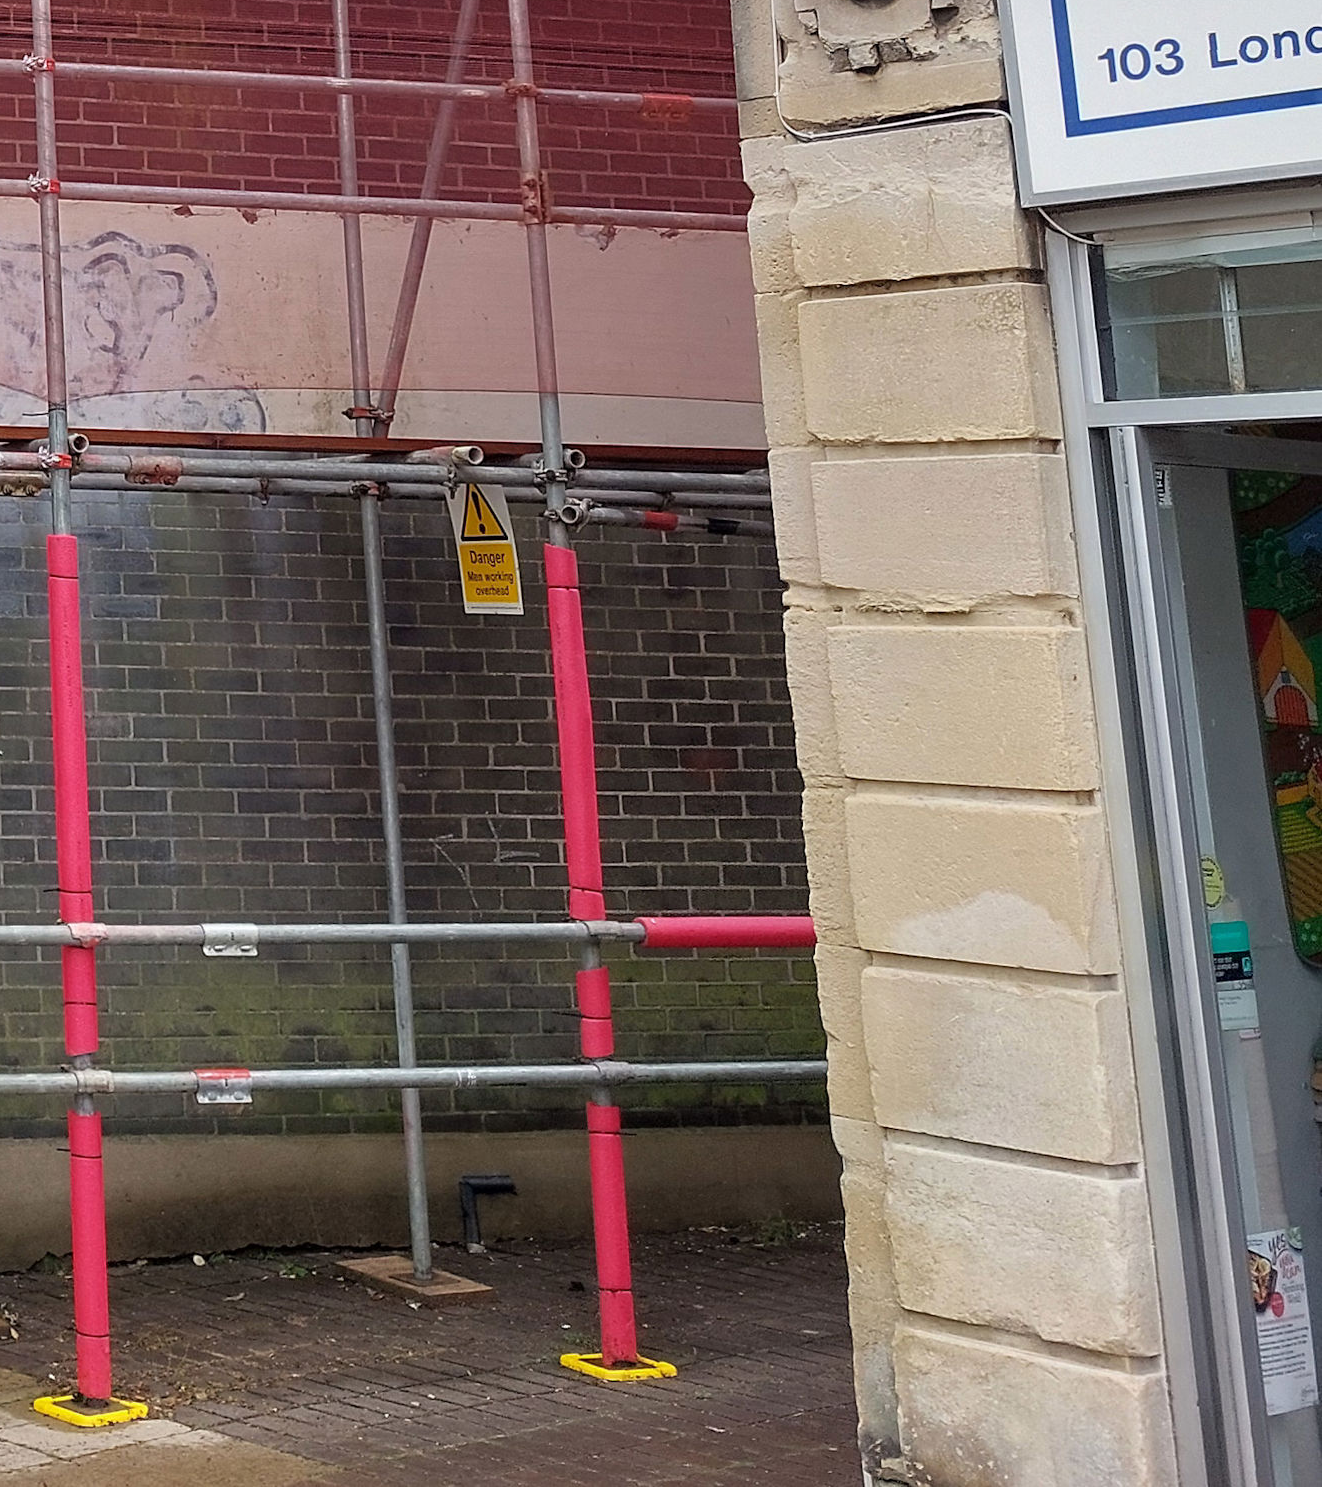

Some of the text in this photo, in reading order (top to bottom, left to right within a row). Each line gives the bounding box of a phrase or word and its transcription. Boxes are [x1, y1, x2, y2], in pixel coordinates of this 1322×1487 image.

[1098, 39, 1184, 83] 103
[469, 550, 505, 567] Danger
[467, 571, 514, 584] Men working
[475, 585, 510, 596] overhead
[1268, 1233, 1290, 1266] yes
